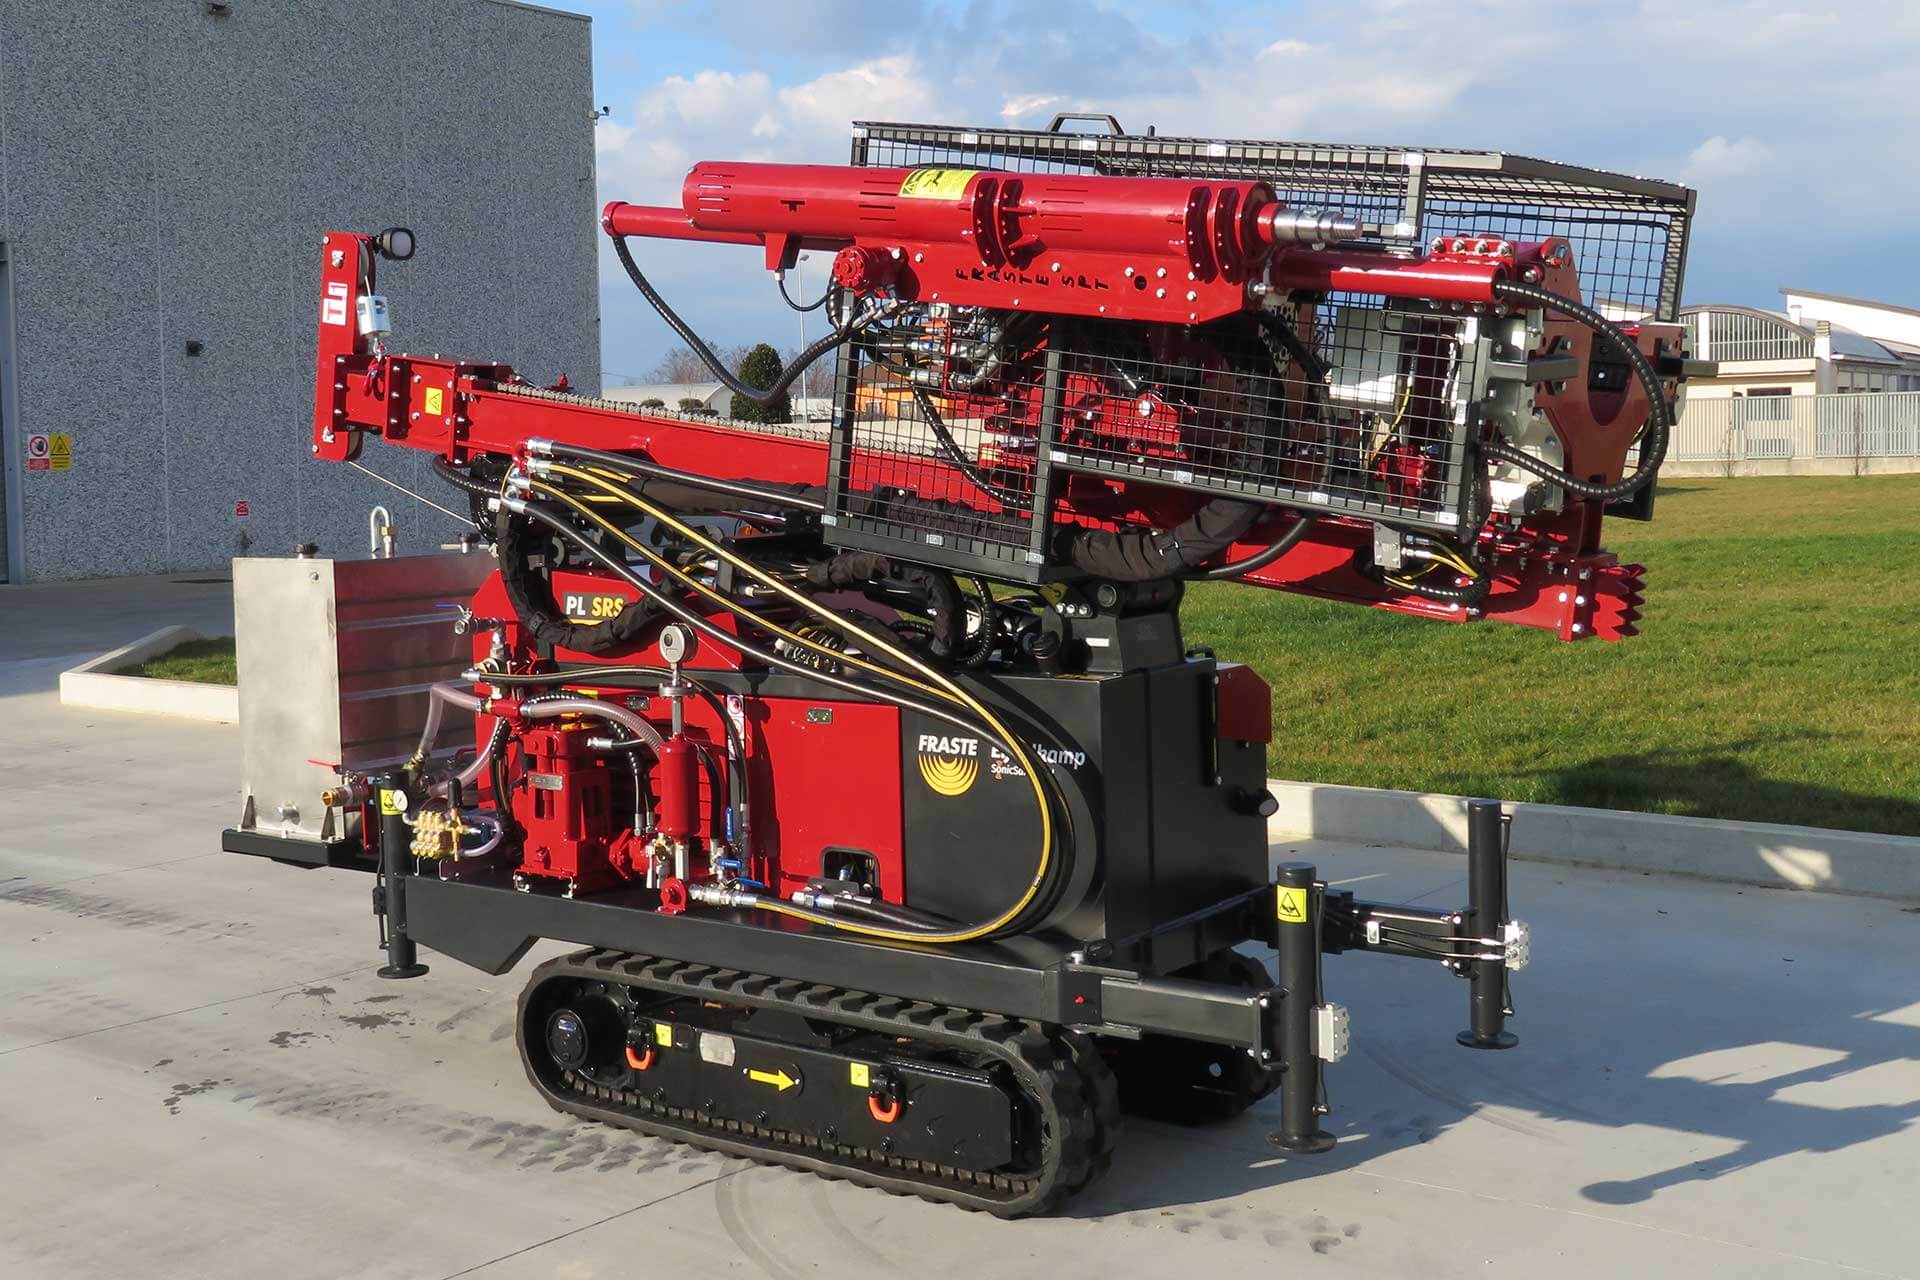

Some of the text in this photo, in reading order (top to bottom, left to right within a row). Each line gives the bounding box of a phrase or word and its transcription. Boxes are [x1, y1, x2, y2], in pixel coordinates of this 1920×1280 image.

[955, 267, 1049, 286] FRASTE
[566, 596, 625, 618] PL SRS
[918, 734, 978, 756] FRASTE
